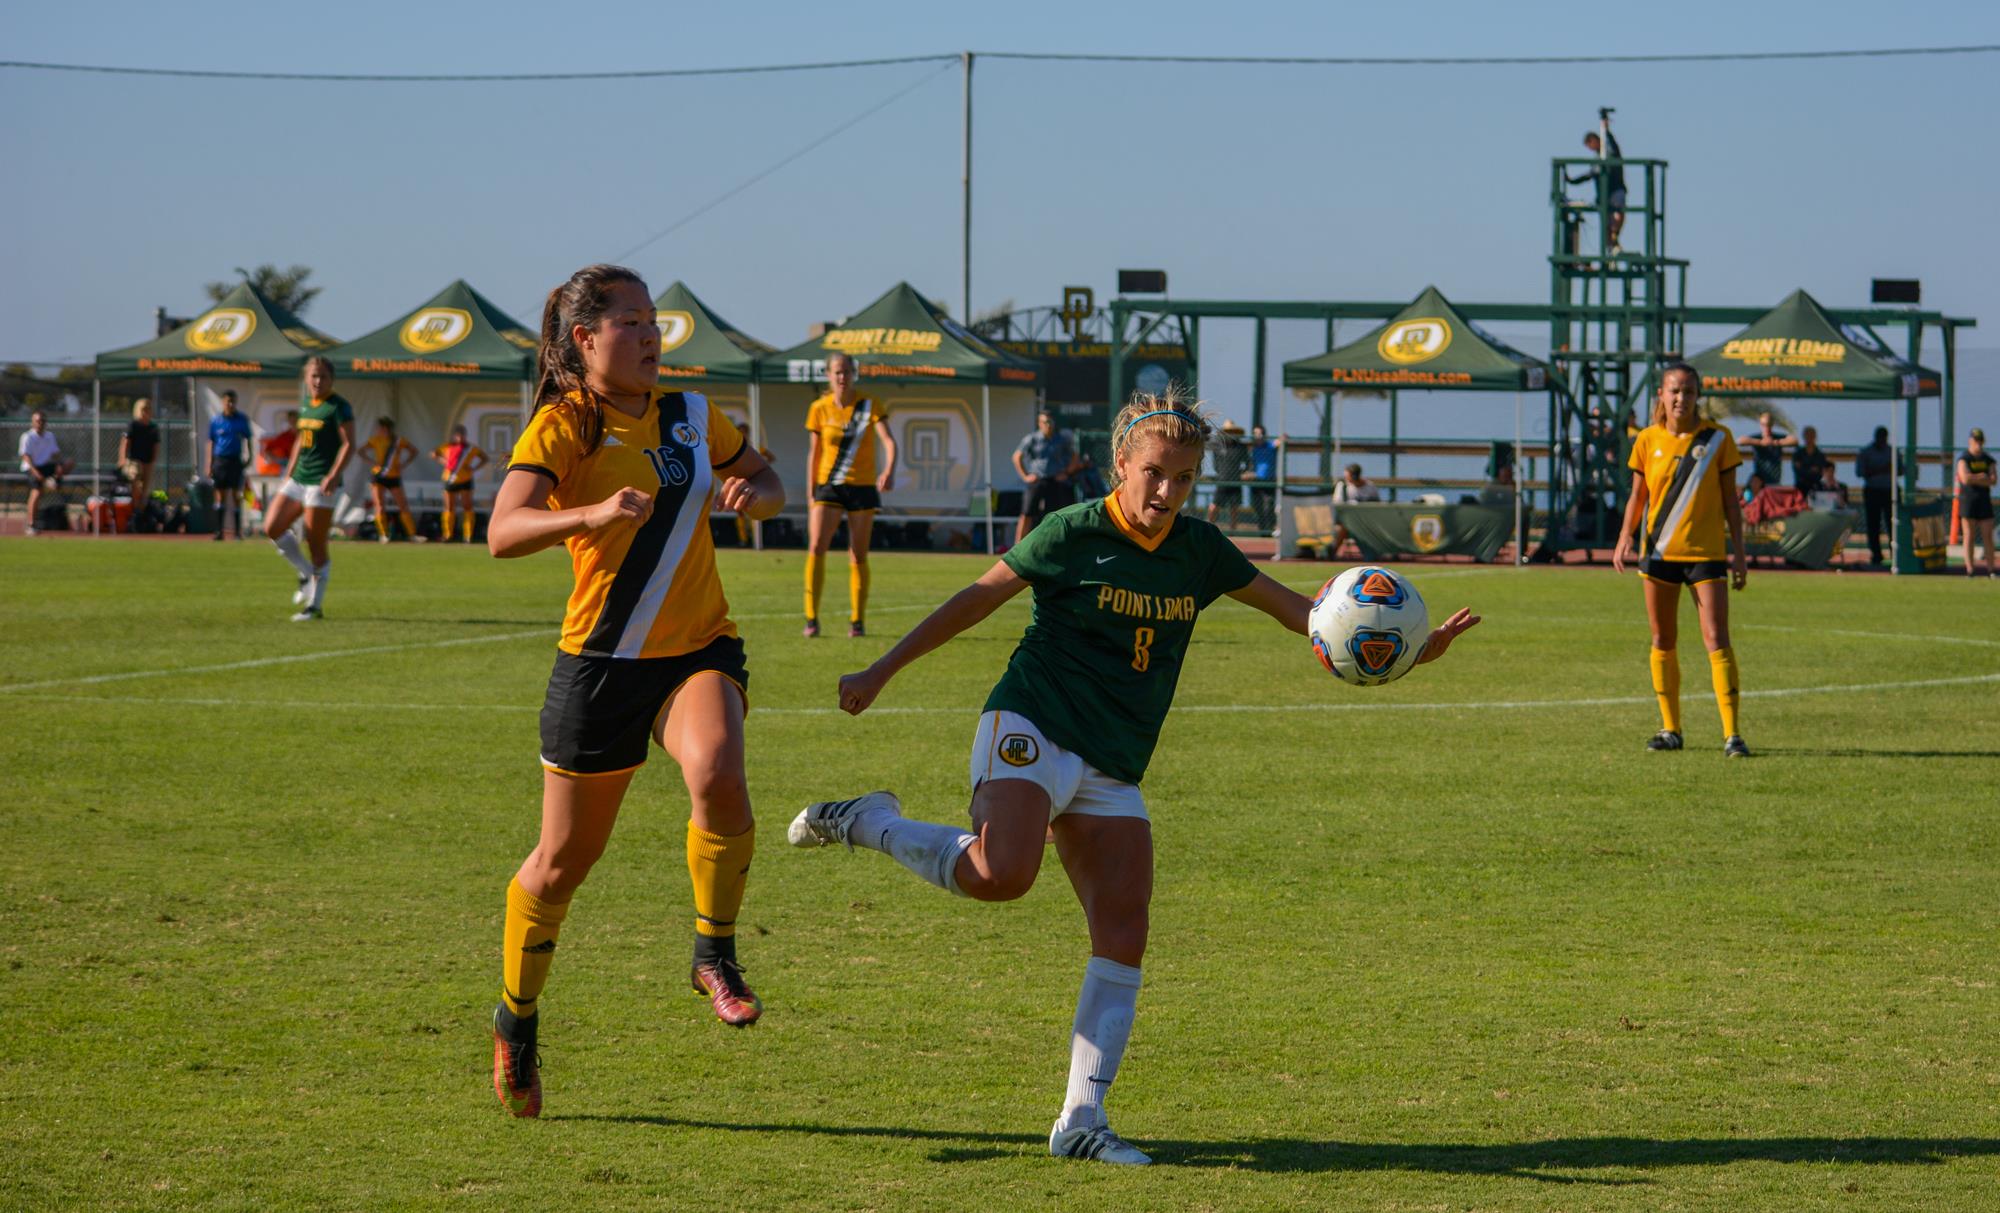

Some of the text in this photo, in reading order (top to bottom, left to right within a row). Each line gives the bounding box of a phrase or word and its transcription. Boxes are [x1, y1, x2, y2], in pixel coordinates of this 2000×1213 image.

[1723, 338, 1846, 358] POINT LOMA
[1332, 367, 1472, 385] PLNUsealions.com
[1702, 376, 1844, 392] PLNUsealions.com
[642, 445, 689, 488] 16
[1097, 584, 1197, 621] POINT LOMA
[1131, 626, 1155, 673] 8
